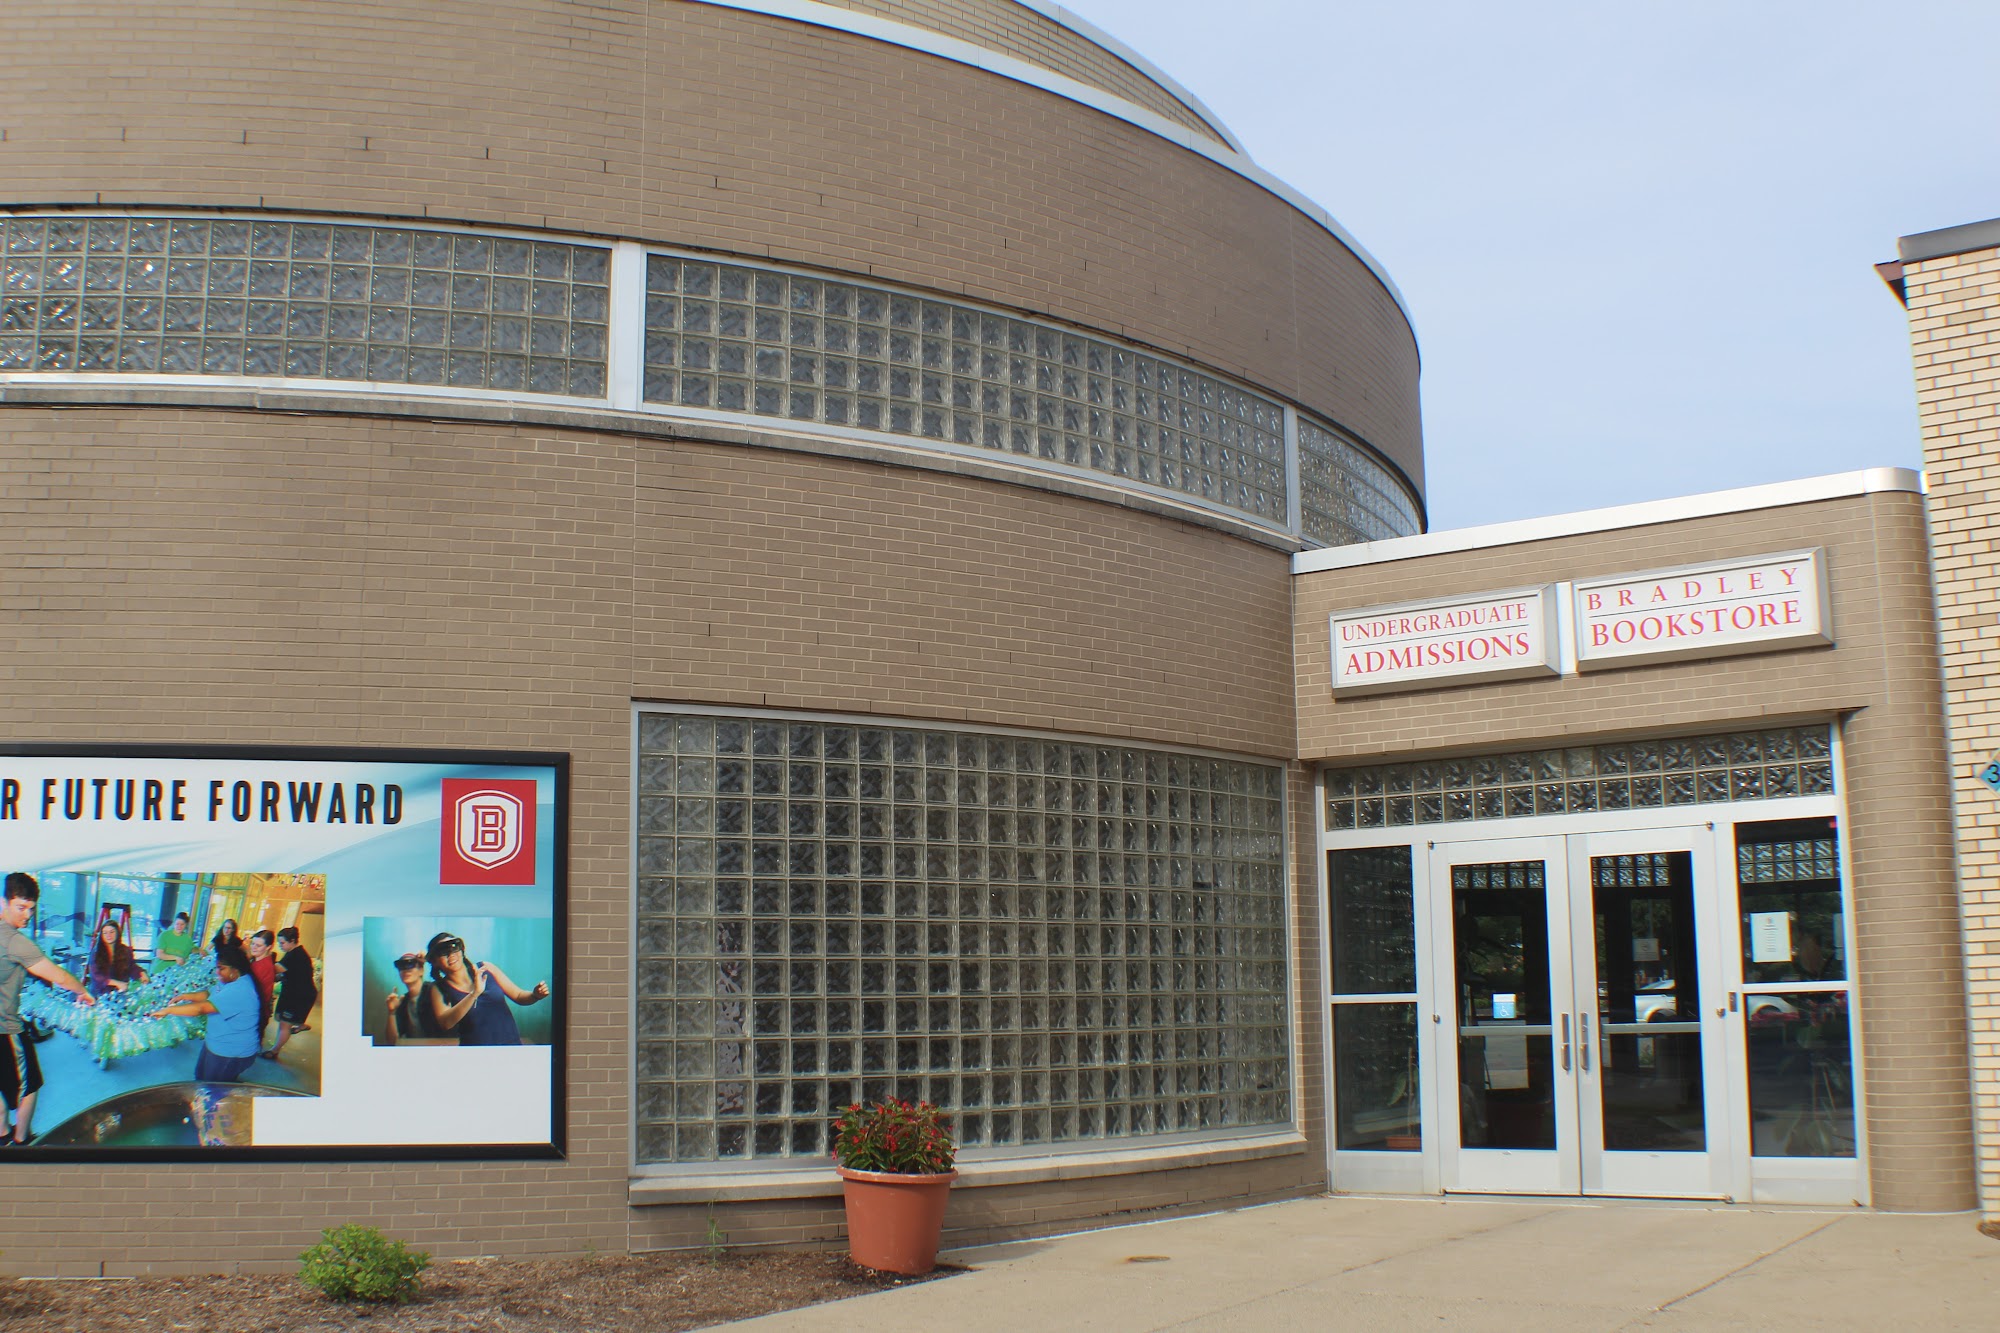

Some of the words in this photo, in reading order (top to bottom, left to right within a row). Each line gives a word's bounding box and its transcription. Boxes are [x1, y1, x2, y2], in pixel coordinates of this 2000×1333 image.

[1587, 567, 1799, 611] BRADLEY
[1341, 602, 1529, 642] UNDERGRADUATE
[1590, 600, 1803, 648] BOOKSTORE
[1344, 632, 1530, 676] ADMISSIONS
[41, 778, 187, 821] FUTURE
[208, 780, 403, 825] FORWARD
[471, 805, 507, 852] B
